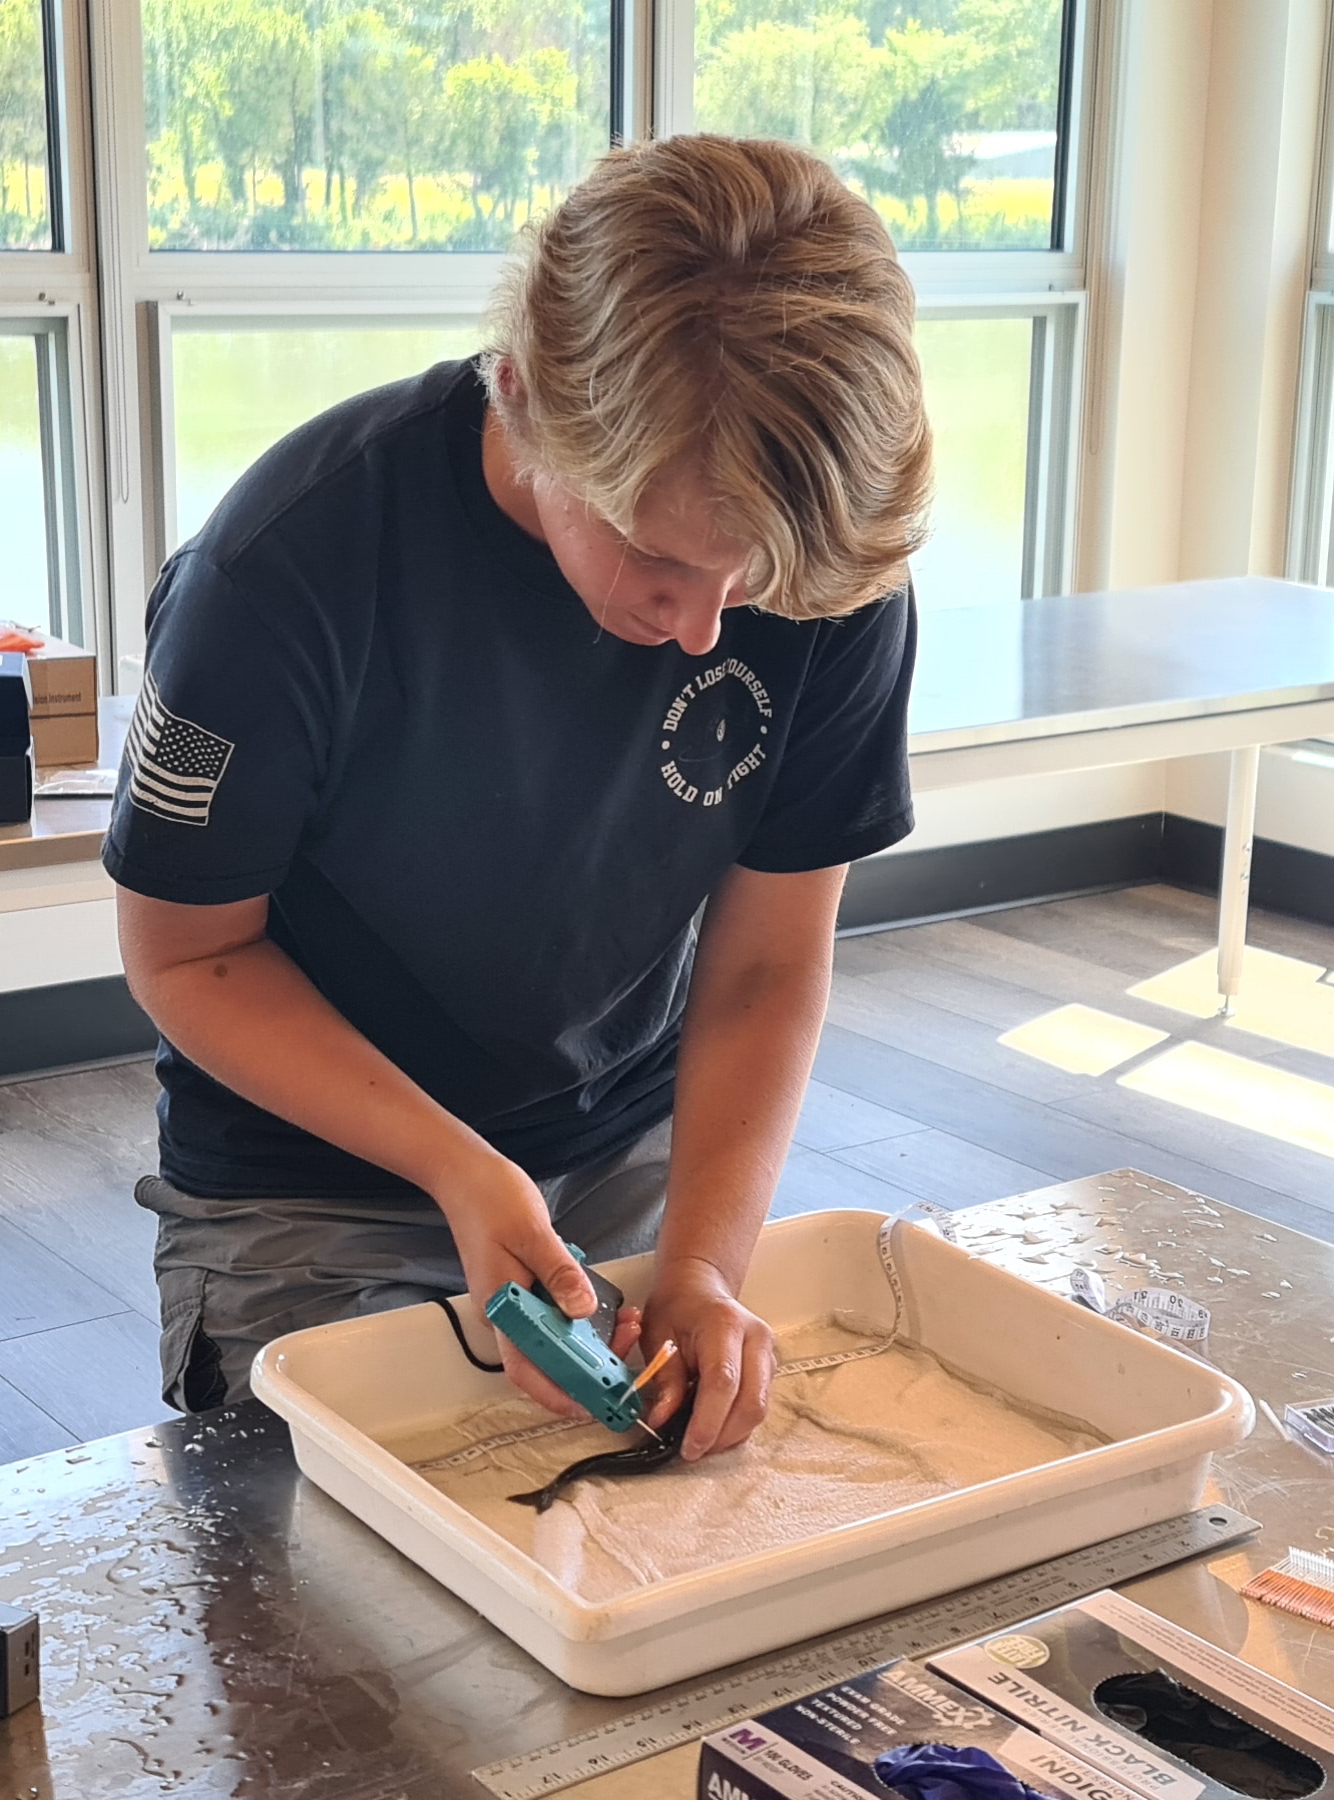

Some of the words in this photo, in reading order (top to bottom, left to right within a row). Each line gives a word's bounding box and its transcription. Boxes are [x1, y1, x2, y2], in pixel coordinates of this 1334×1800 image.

[662, 683, 696, 732] DON'T
[727, 658, 773, 718] OURSELF
[660, 760, 698, 802] HOLD
[702, 786, 723, 807] ON
[811, 1699, 863, 1731] TEXTURED
[826, 1692, 870, 1719] POWDER
[868, 1717, 898, 1736] FREE
[841, 1686, 871, 1704] EXAM
[870, 1703, 906, 1726] GRADE
[879, 1670, 975, 1727] AMMEX
[987, 1671, 1088, 1732] NITRILE
[729, 1728, 767, 1750] M
[795, 1704, 861, 1745] NON-STERILE
[779, 1758, 814, 1781] GLOVES
[1085, 1734, 1178, 1786] BLACK
